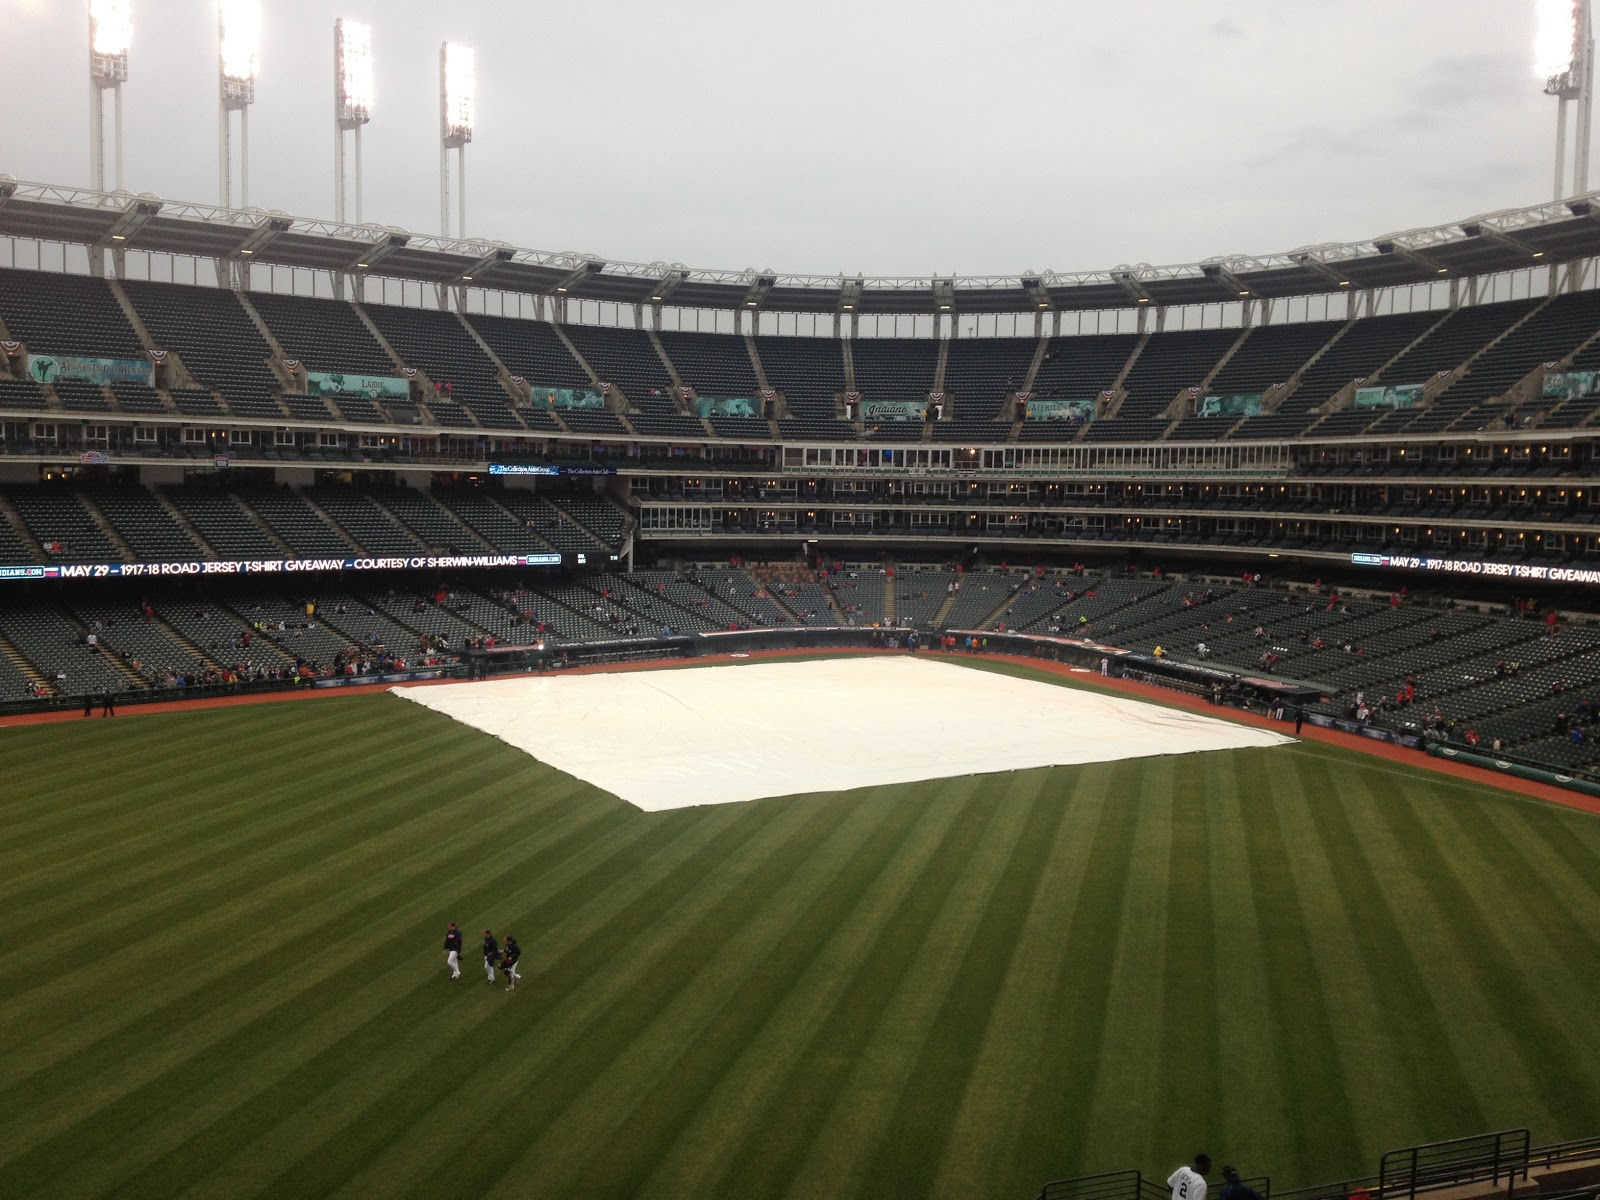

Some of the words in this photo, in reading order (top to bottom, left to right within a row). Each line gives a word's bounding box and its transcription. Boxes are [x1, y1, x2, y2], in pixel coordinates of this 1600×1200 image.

[864, 404, 908, 416] Indians
[60, 565, 92, 577] MAY
[94, 564, 109, 577] 29
[120, 564, 160, 576] 1917-18
[162, 563, 200, 575] ROAD
[201, 561, 241, 574] JERSEY
[244, 560, 283, 572] T-SHIRT
[285, 559, 345, 571] GIVEAWAY
[354, 557, 410, 569] COURTESY
[411, 557, 427, 568] OF
[428, 555, 518, 568] SHERWIN-WILLIAMS
[1390, 556, 1408, 567] MAY
[1409, 557, 1420, 568] 29
[1427, 559, 1453, 571] 1917-18
[1454, 561, 1481, 574] ROAD
[1482, 562, 1515, 576] JERSEY
[1515, 565, 1548, 579] T-SHIRT
[1180, 1183, 1187, 1199] 2
